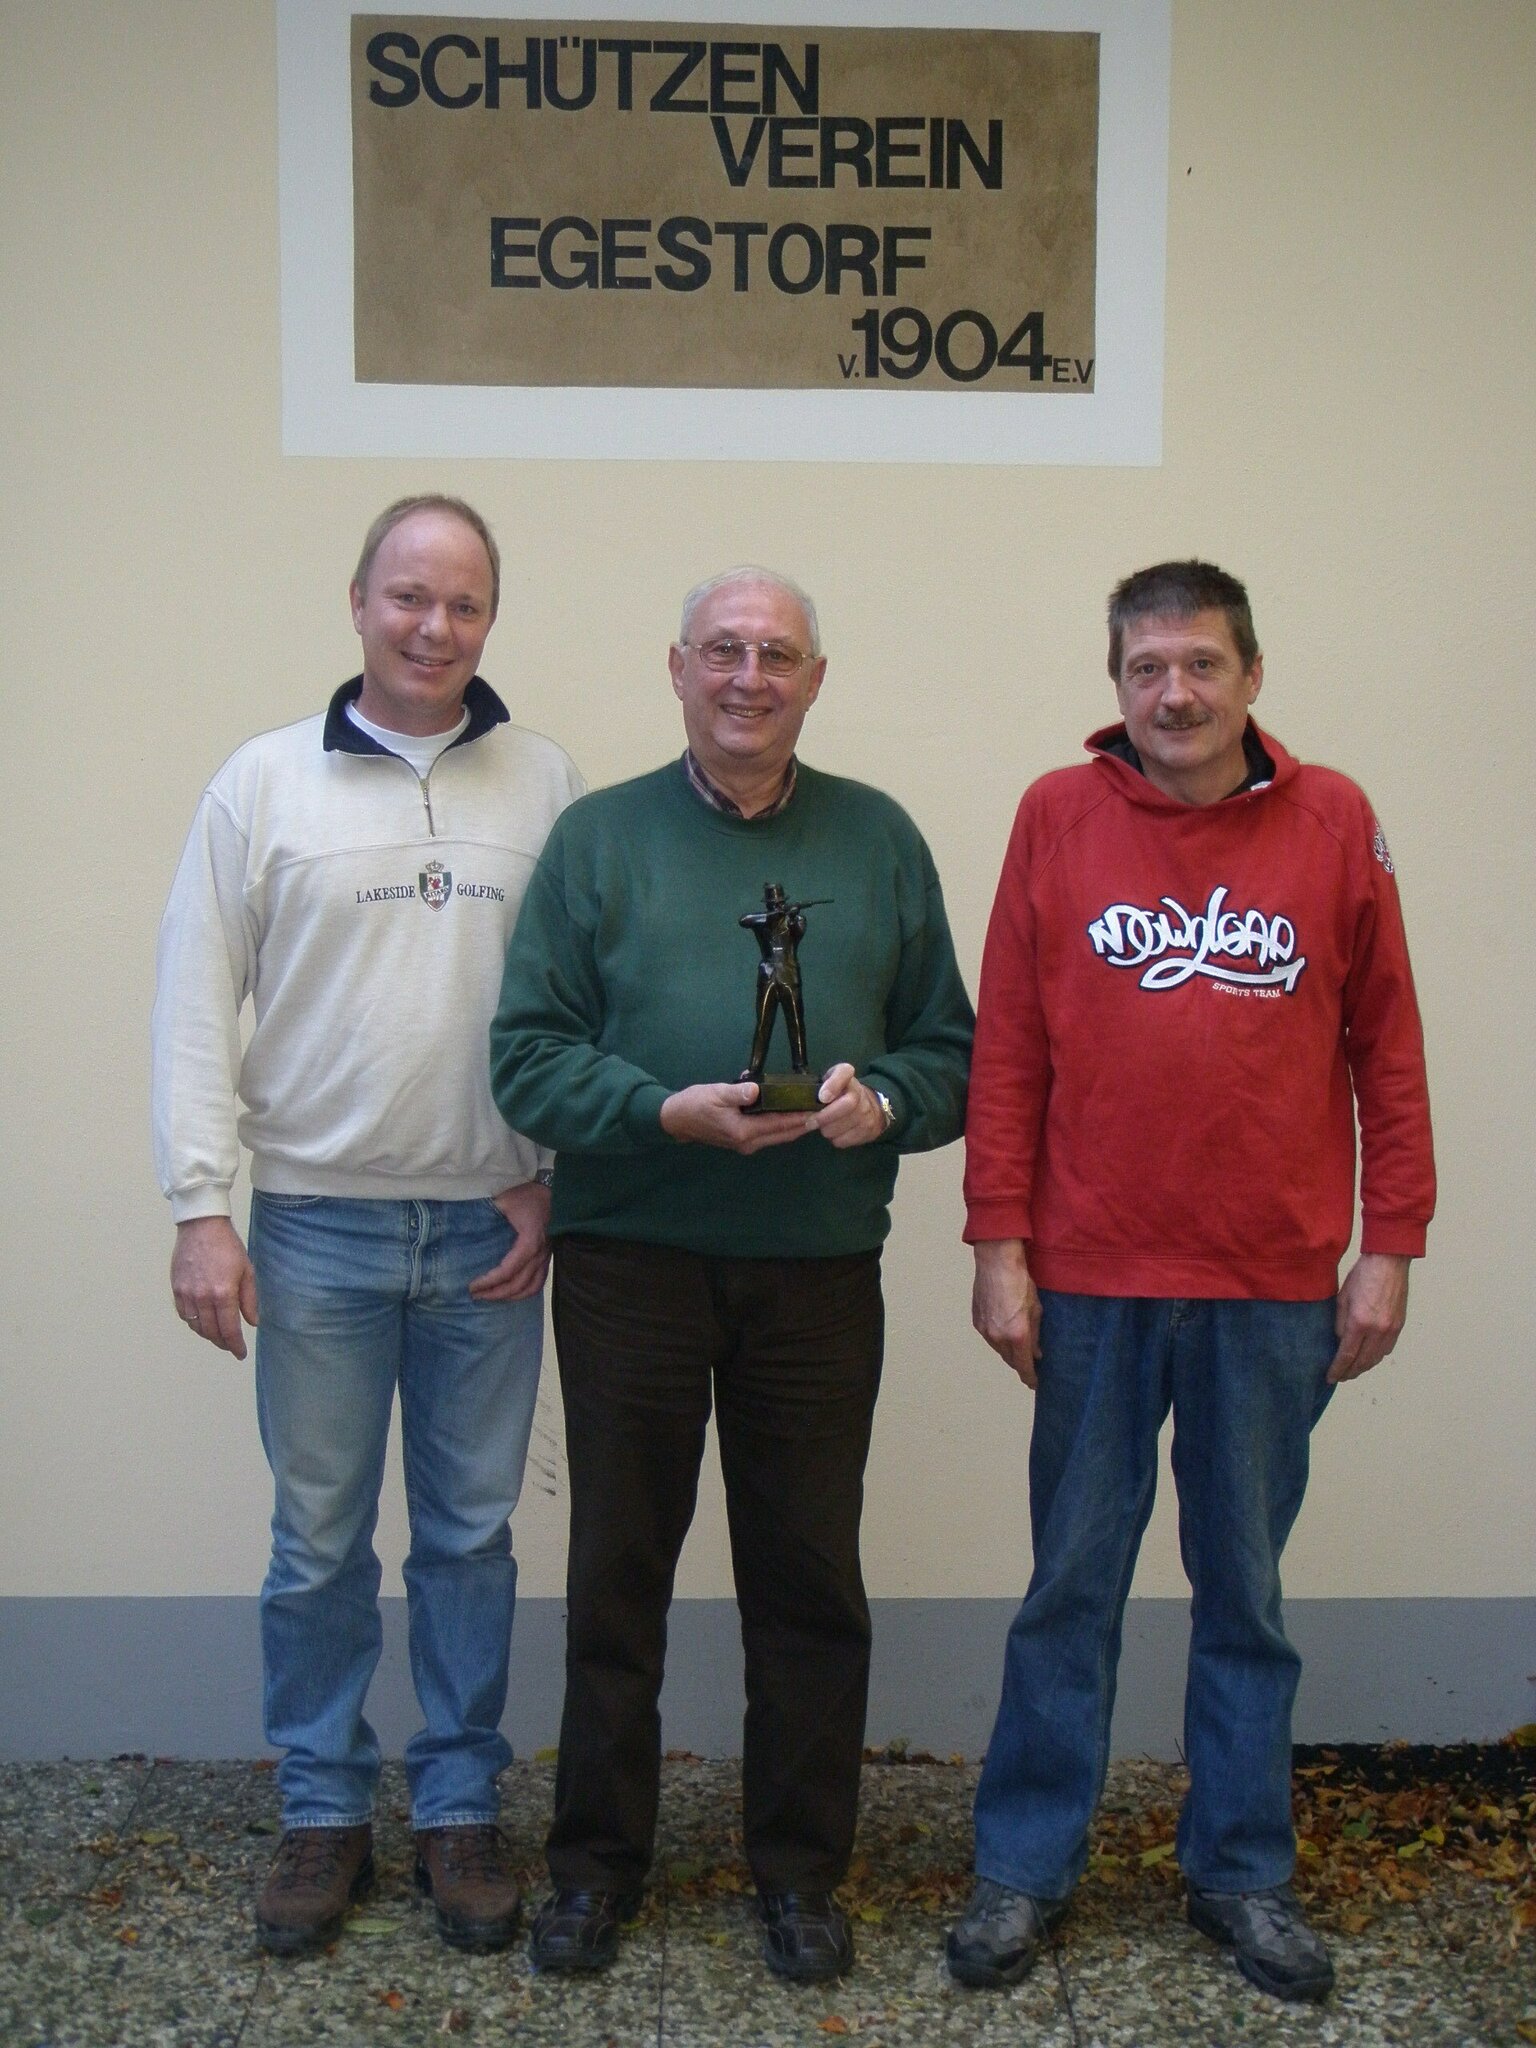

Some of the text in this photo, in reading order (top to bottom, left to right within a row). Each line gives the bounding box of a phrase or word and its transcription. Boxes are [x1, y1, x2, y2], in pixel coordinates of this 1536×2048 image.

[365, 32, 820, 116] SCHÜTZEN
[710, 116, 1003, 190] VEREIN
[490, 216, 932, 296] EGESTORF
[851, 306, 1053, 383] 1904
[1052, 358, 1094, 384] E.V
[356, 883, 505, 904] LAKESIDE GOLFING
[1212, 982, 1281, 998] SPORTS TEAM
